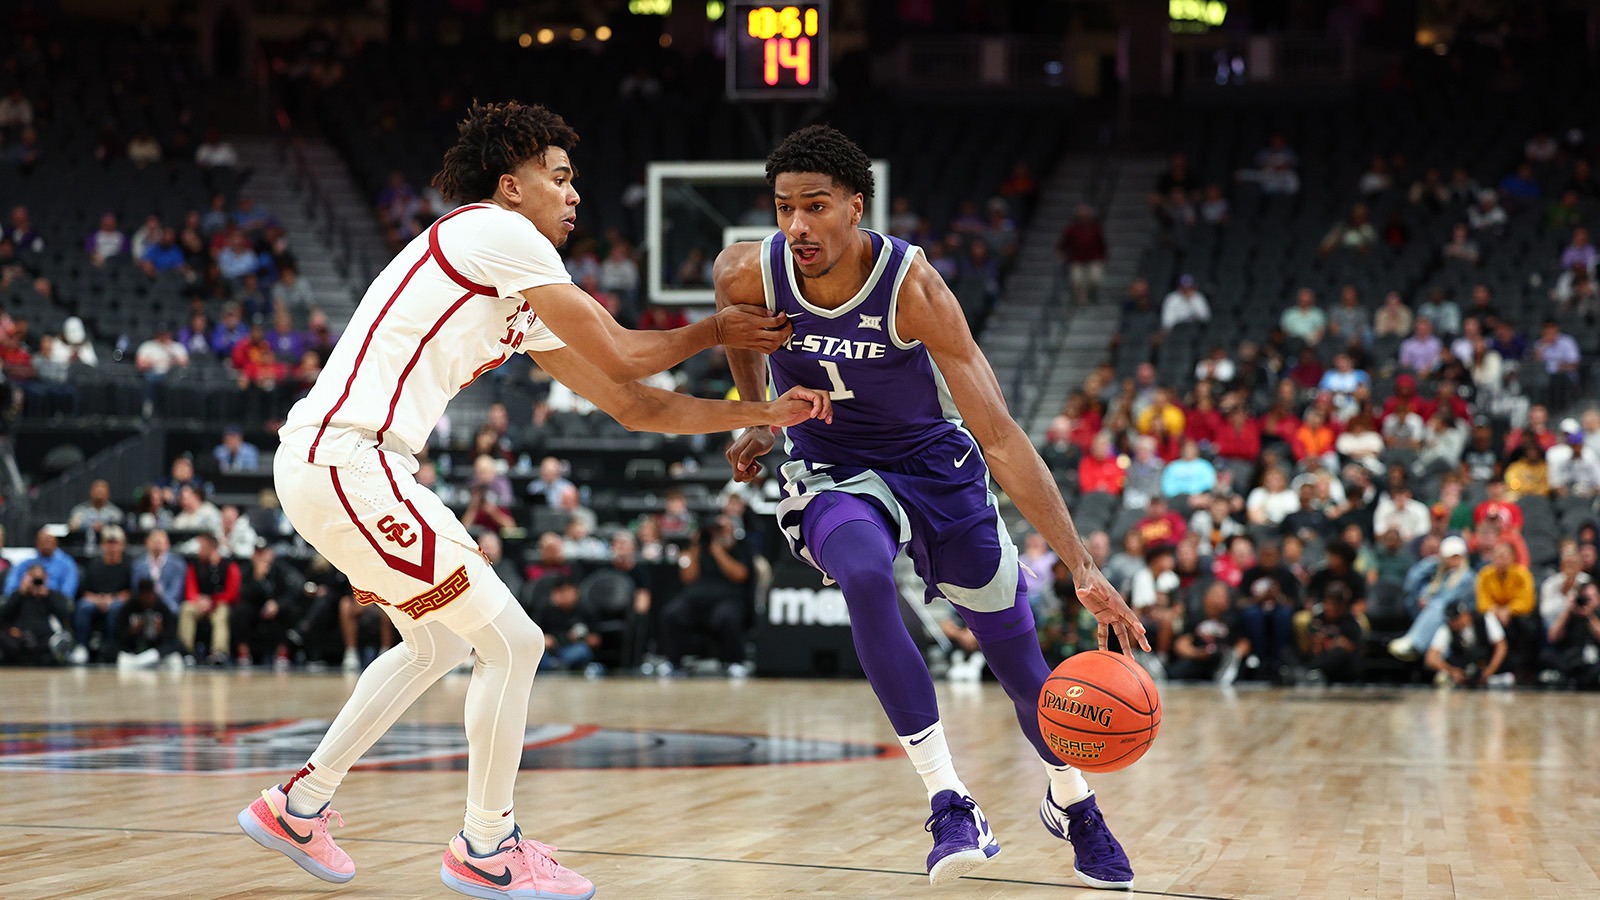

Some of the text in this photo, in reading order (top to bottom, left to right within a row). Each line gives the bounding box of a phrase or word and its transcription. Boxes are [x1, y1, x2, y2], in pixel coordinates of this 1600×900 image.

[764, 37, 810, 85] 14
[818, 359, 856, 401] 1
[1042, 689, 1114, 729] SPALDING
[1043, 726, 1106, 753] LEGACY
